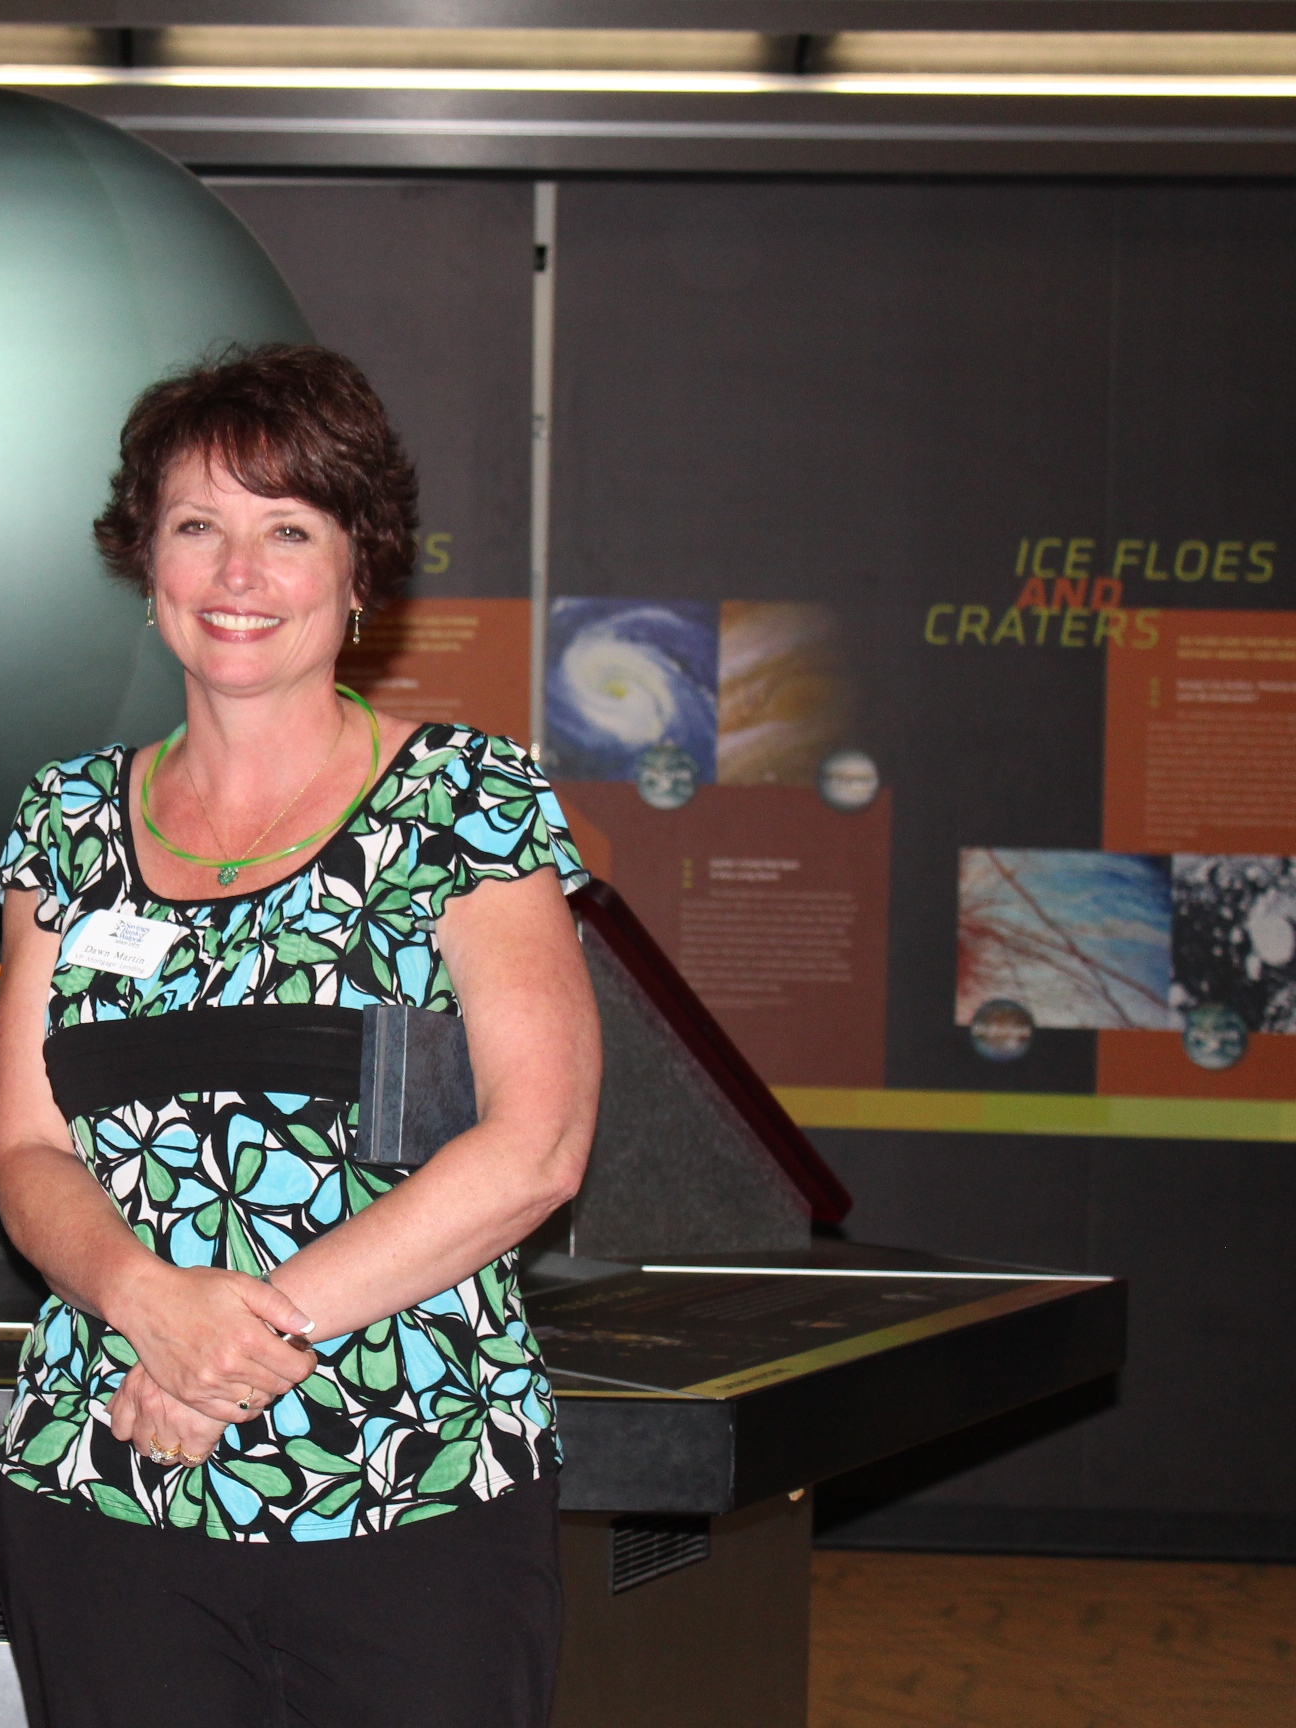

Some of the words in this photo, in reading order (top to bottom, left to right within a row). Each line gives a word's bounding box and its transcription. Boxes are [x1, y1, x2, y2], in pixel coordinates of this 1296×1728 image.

[1015, 537, 1095, 579] ICE
[1111, 539, 1278, 583] FLOES
[1016, 576, 1124, 611] AND
[924, 603, 1163, 649] CRATERS
[122, 928, 139, 937] Bank
[126, 922, 151, 933] Savings
[84, 945, 110, 957] Dawn
[114, 951, 145, 965] Martin
[86, 956, 117, 968] Mortgage
[119, 963, 146, 974] Lending
